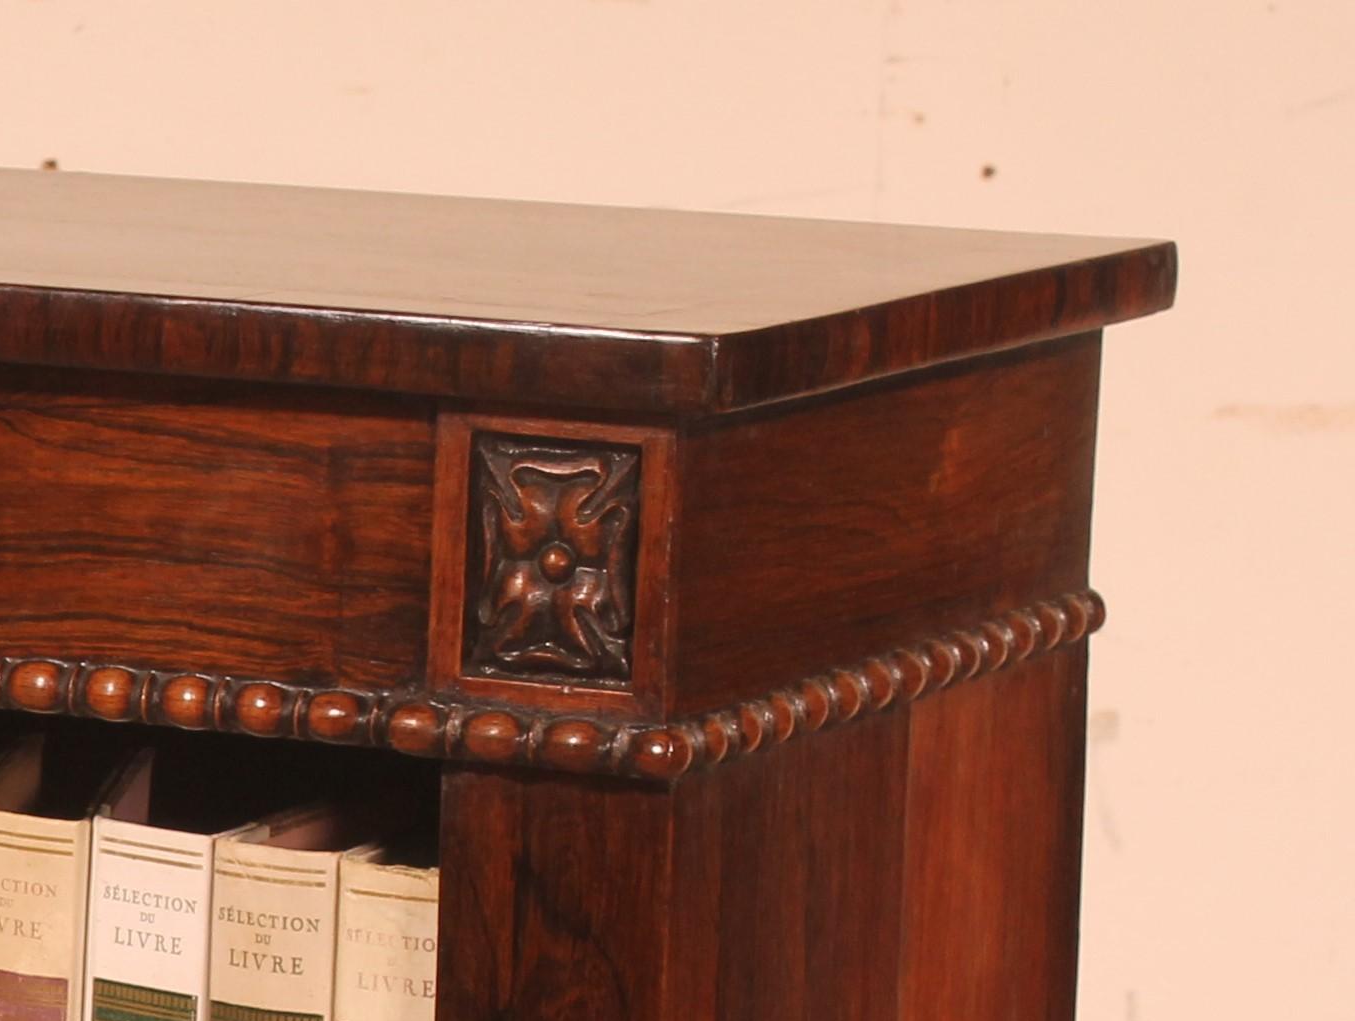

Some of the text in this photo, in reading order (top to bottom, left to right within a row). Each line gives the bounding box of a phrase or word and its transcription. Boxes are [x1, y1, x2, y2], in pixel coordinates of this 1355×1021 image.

[102, 885, 198, 914] SÉLECTION
[139, 911, 155, 924] DU
[217, 905, 322, 933] SÉLECTION
[114, 926, 182, 956] LIVRE
[254, 932, 271, 946] DU
[228, 948, 305, 976] LIVRE
[358, 971, 436, 999] LIVRE
